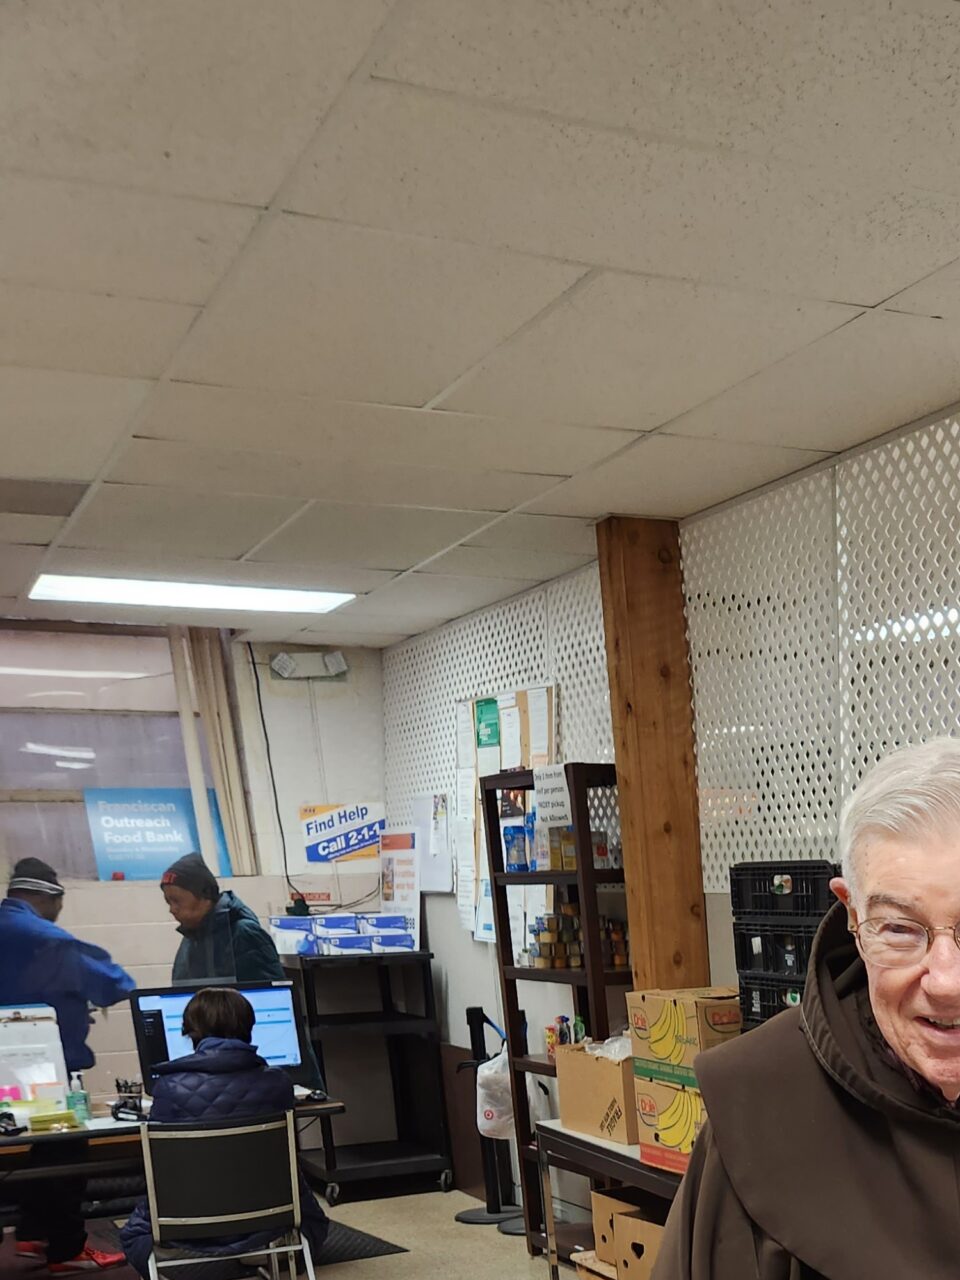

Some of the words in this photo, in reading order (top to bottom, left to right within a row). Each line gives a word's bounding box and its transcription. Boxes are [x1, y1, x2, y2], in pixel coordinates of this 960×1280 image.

[97, 800, 176, 813] Franciscan
[101, 816, 171, 828] Outreach
[305, 816, 335, 836] Find
[338, 805, 368, 825] Help
[104, 832, 143, 844] Food
[145, 830, 184, 843] Bank
[318, 835, 346, 856] Call
[349, 823, 381, 846] 2-1-1
